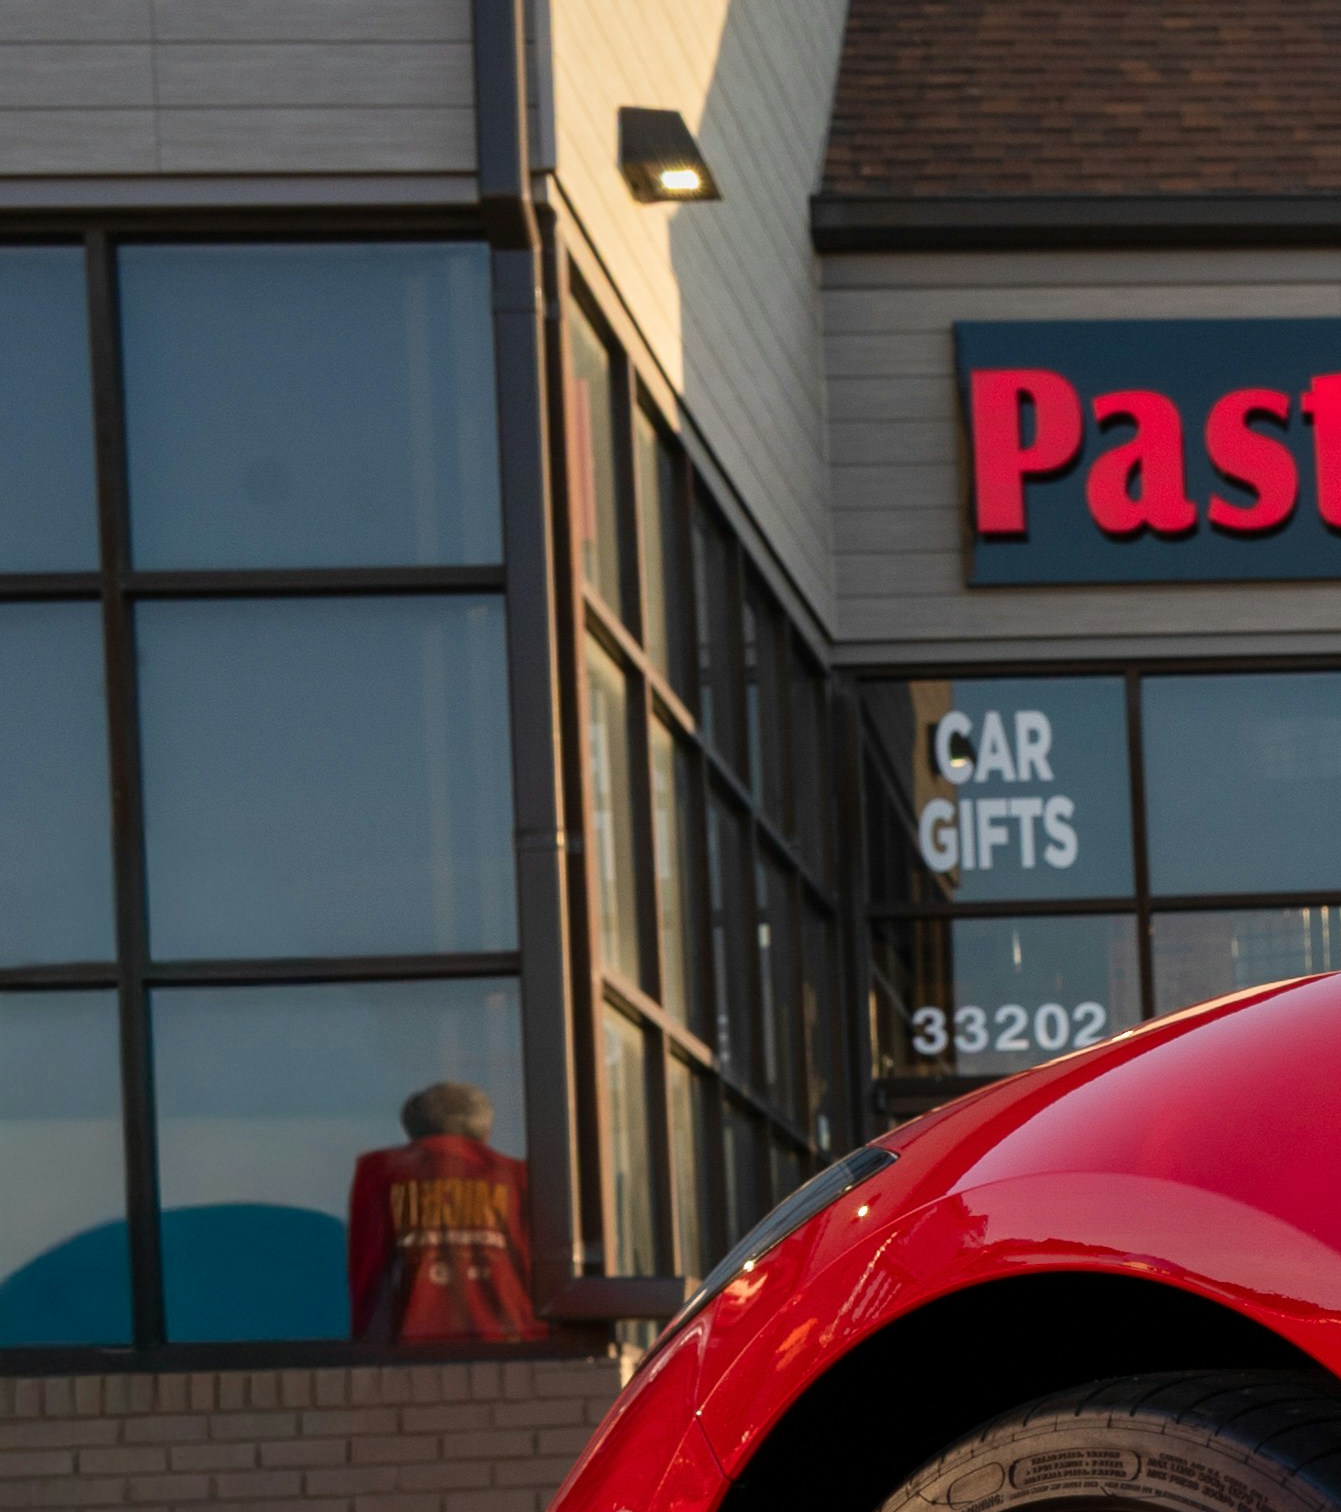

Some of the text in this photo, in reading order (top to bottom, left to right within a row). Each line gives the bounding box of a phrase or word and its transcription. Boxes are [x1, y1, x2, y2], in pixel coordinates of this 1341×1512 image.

[935, 710, 1054, 784] CAR
[918, 795, 1079, 872] GIFTS
[912, 1001, 1108, 1056] 33202
